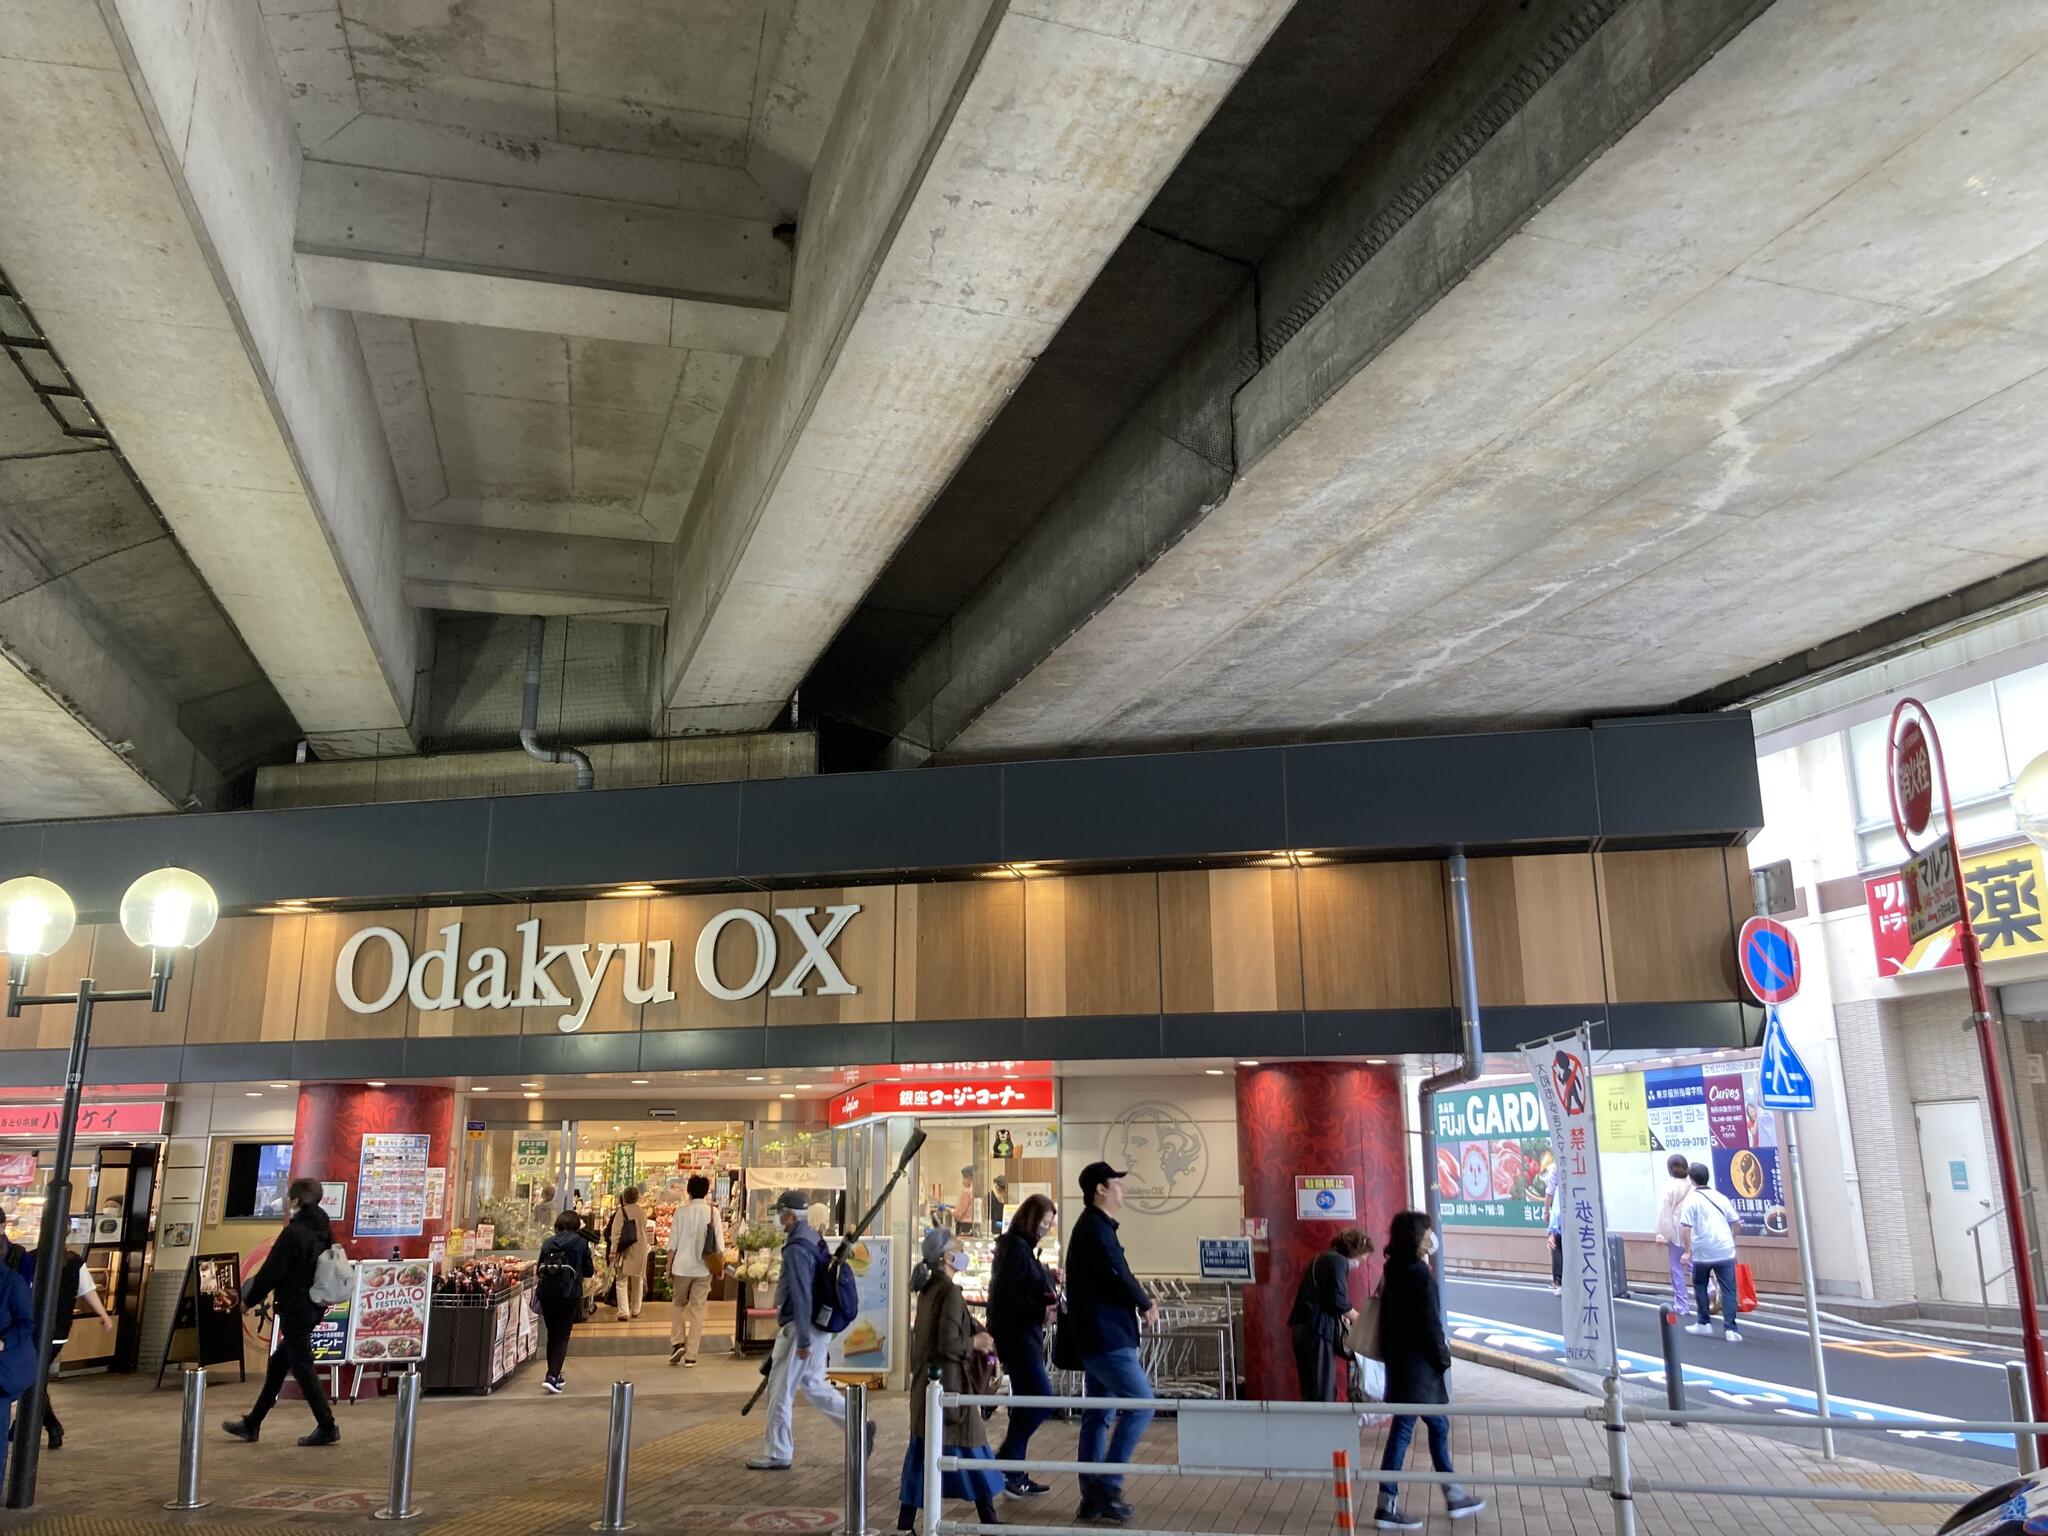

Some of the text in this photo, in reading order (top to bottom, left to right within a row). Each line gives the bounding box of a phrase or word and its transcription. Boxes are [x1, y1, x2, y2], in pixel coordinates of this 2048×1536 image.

[1898, 746, 1930, 805] 消火栓
[1965, 858, 2044, 951] 薬
[335, 904, 862, 1033] Odakyu OX
[899, 1085, 1025, 1106] 銀座コージーコーナー
[1708, 1085, 1740, 1102] Curves
[42, 1108, 118, 1130] ハケイ
[1439, 1114, 1466, 1136] FUJI
[361, 1287, 424, 1309] TOMATO
[375, 1298, 412, 1309] FESTIVAL
